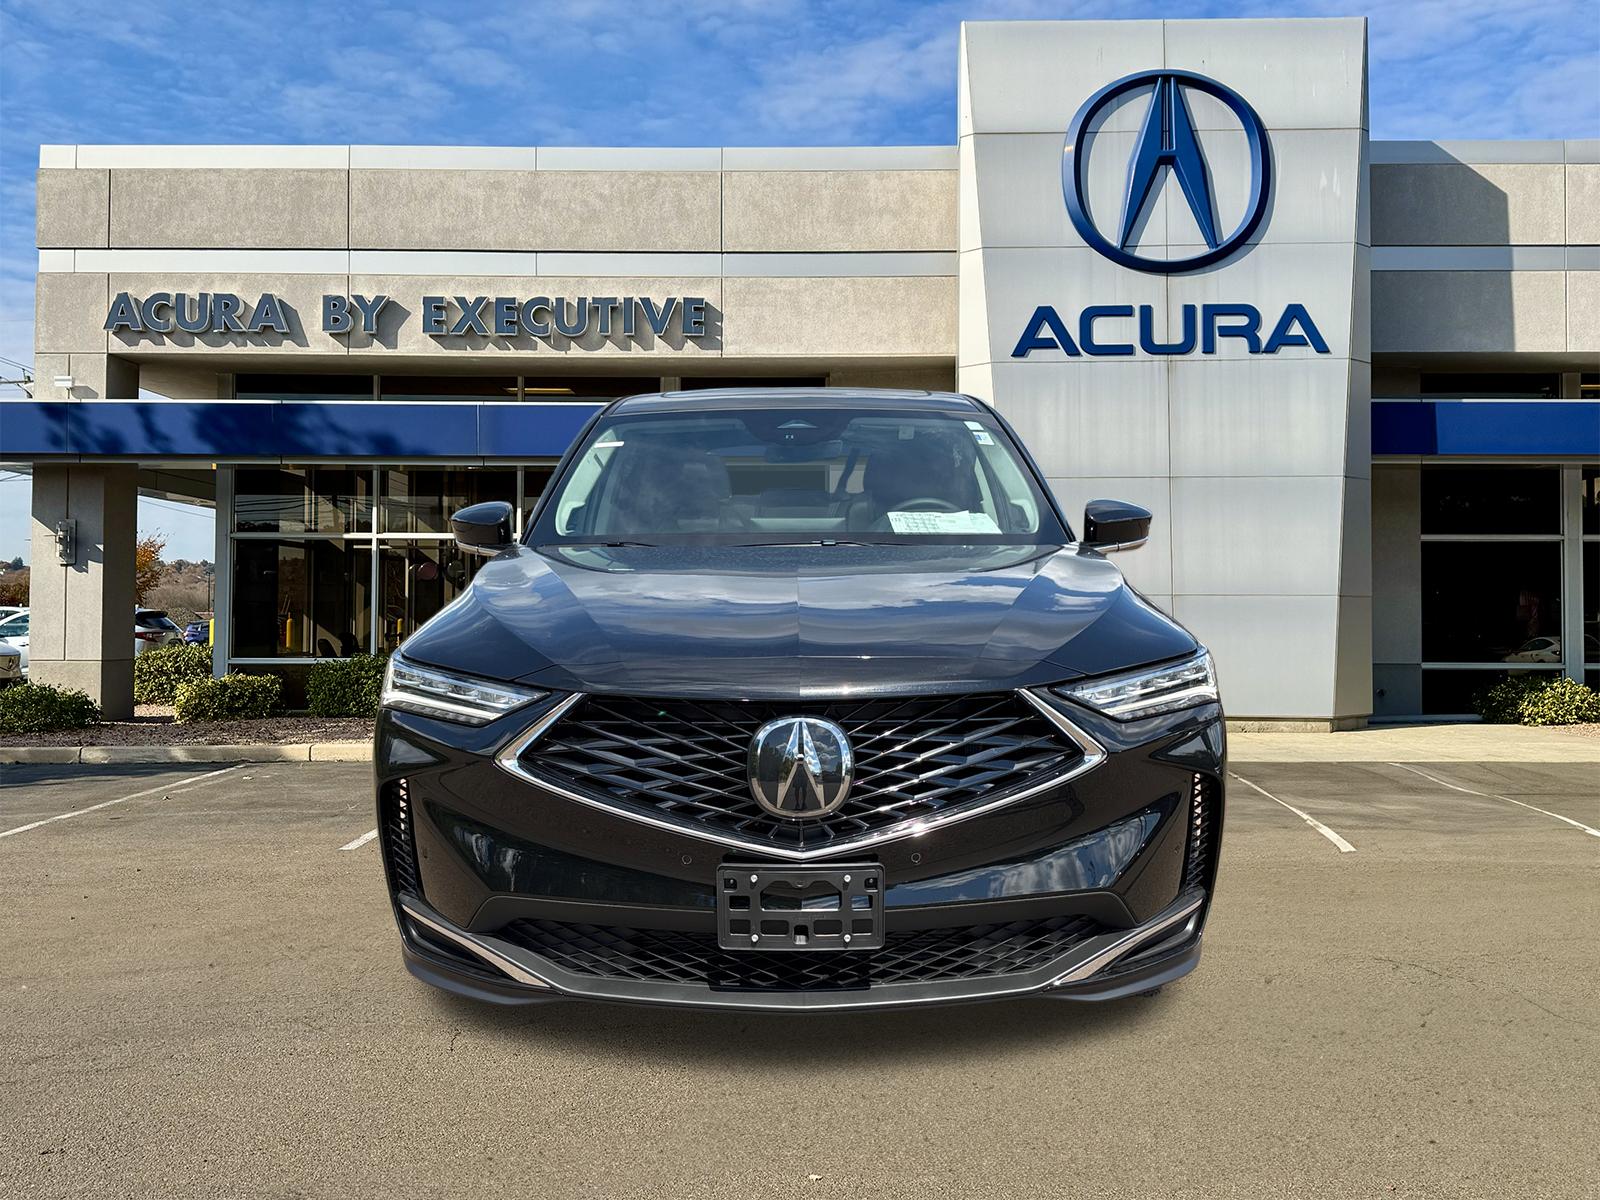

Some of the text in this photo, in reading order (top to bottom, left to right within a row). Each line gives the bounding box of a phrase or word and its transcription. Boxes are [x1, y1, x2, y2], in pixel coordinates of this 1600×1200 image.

[104, 292, 707, 338] ACURA BY EXECUTIVE
[1011, 304, 1332, 357] ACURA
